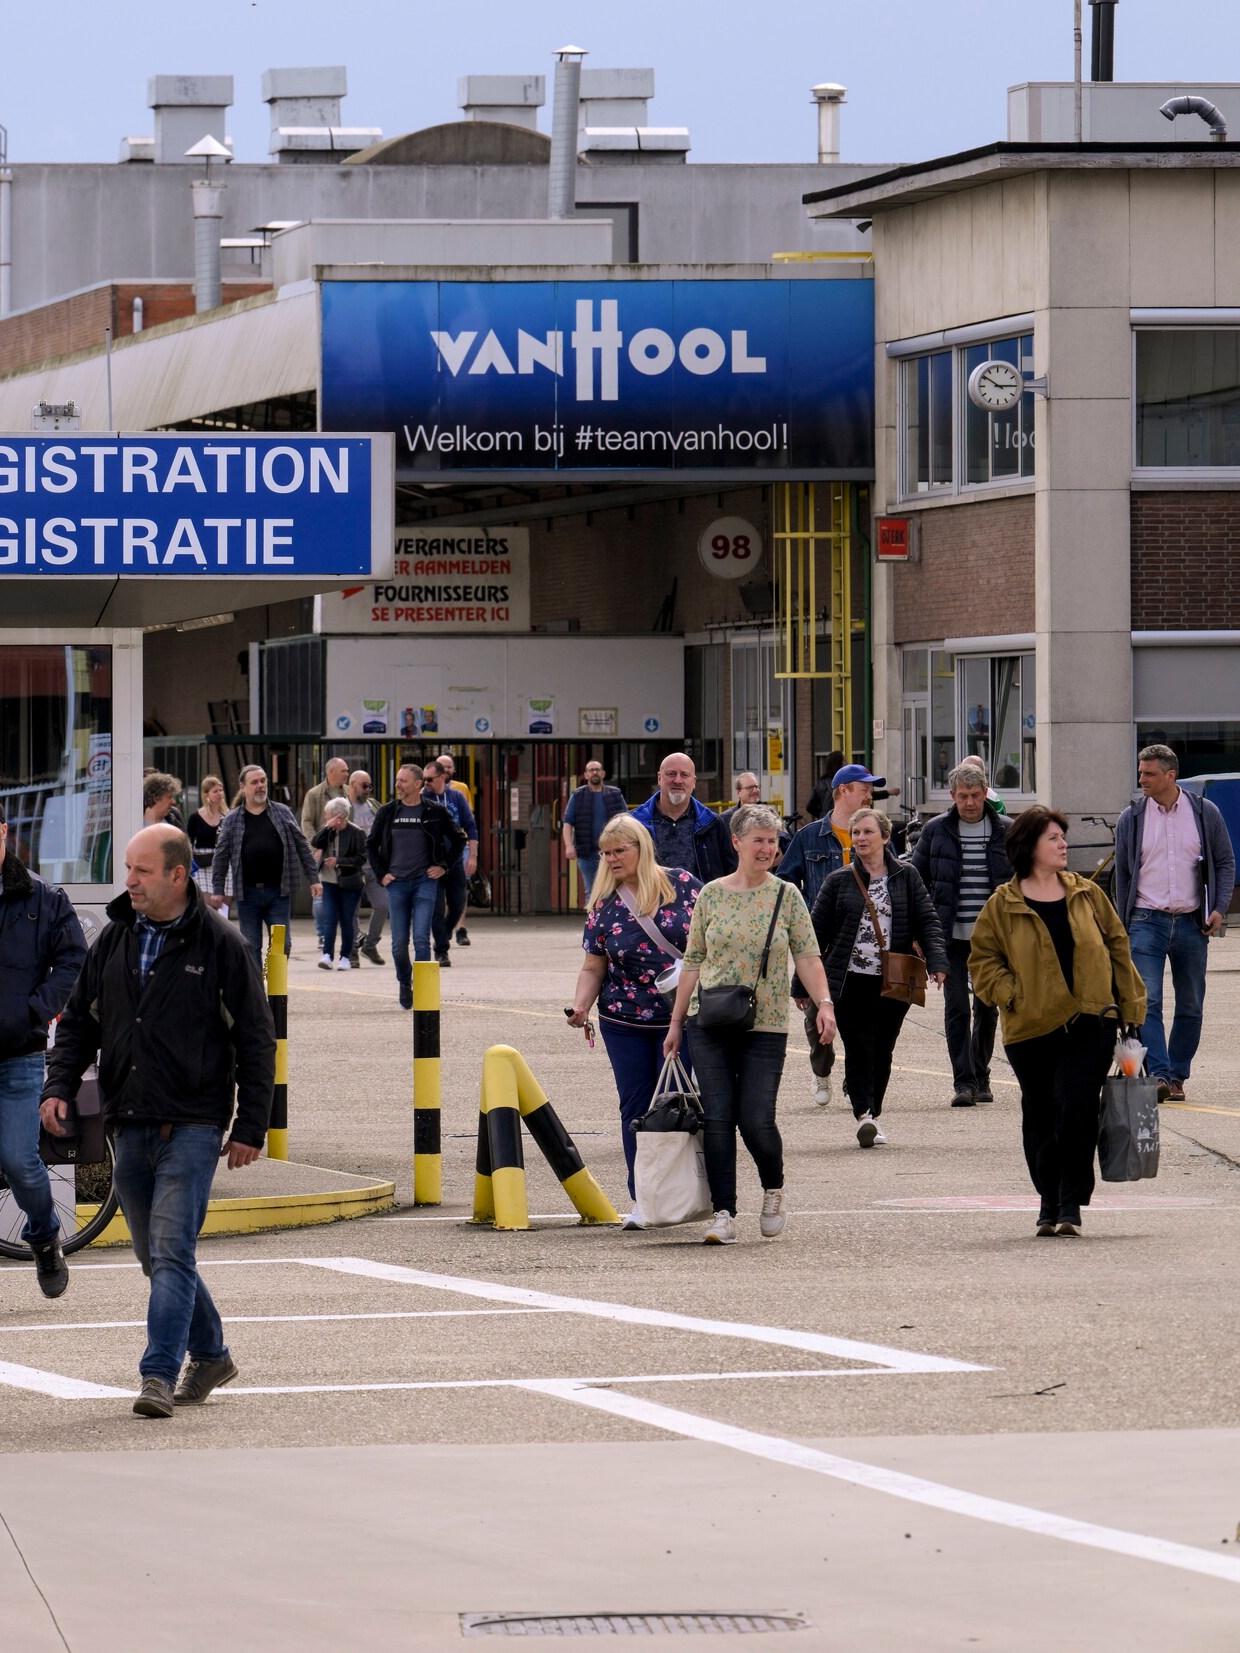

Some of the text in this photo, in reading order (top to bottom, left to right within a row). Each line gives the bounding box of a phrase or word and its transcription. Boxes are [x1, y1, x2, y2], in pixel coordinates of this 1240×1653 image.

[403, 423, 789, 458] Welkom bij #teamvanhool!
[394, 537, 510, 557] VERANCIERS
[711, 534, 752, 560] 98
[414, 560, 512, 577] AANMELDEN
[374, 585, 510, 604] FOURNISSEURS
[371, 606, 510, 623] SE PRESENTER ICI
